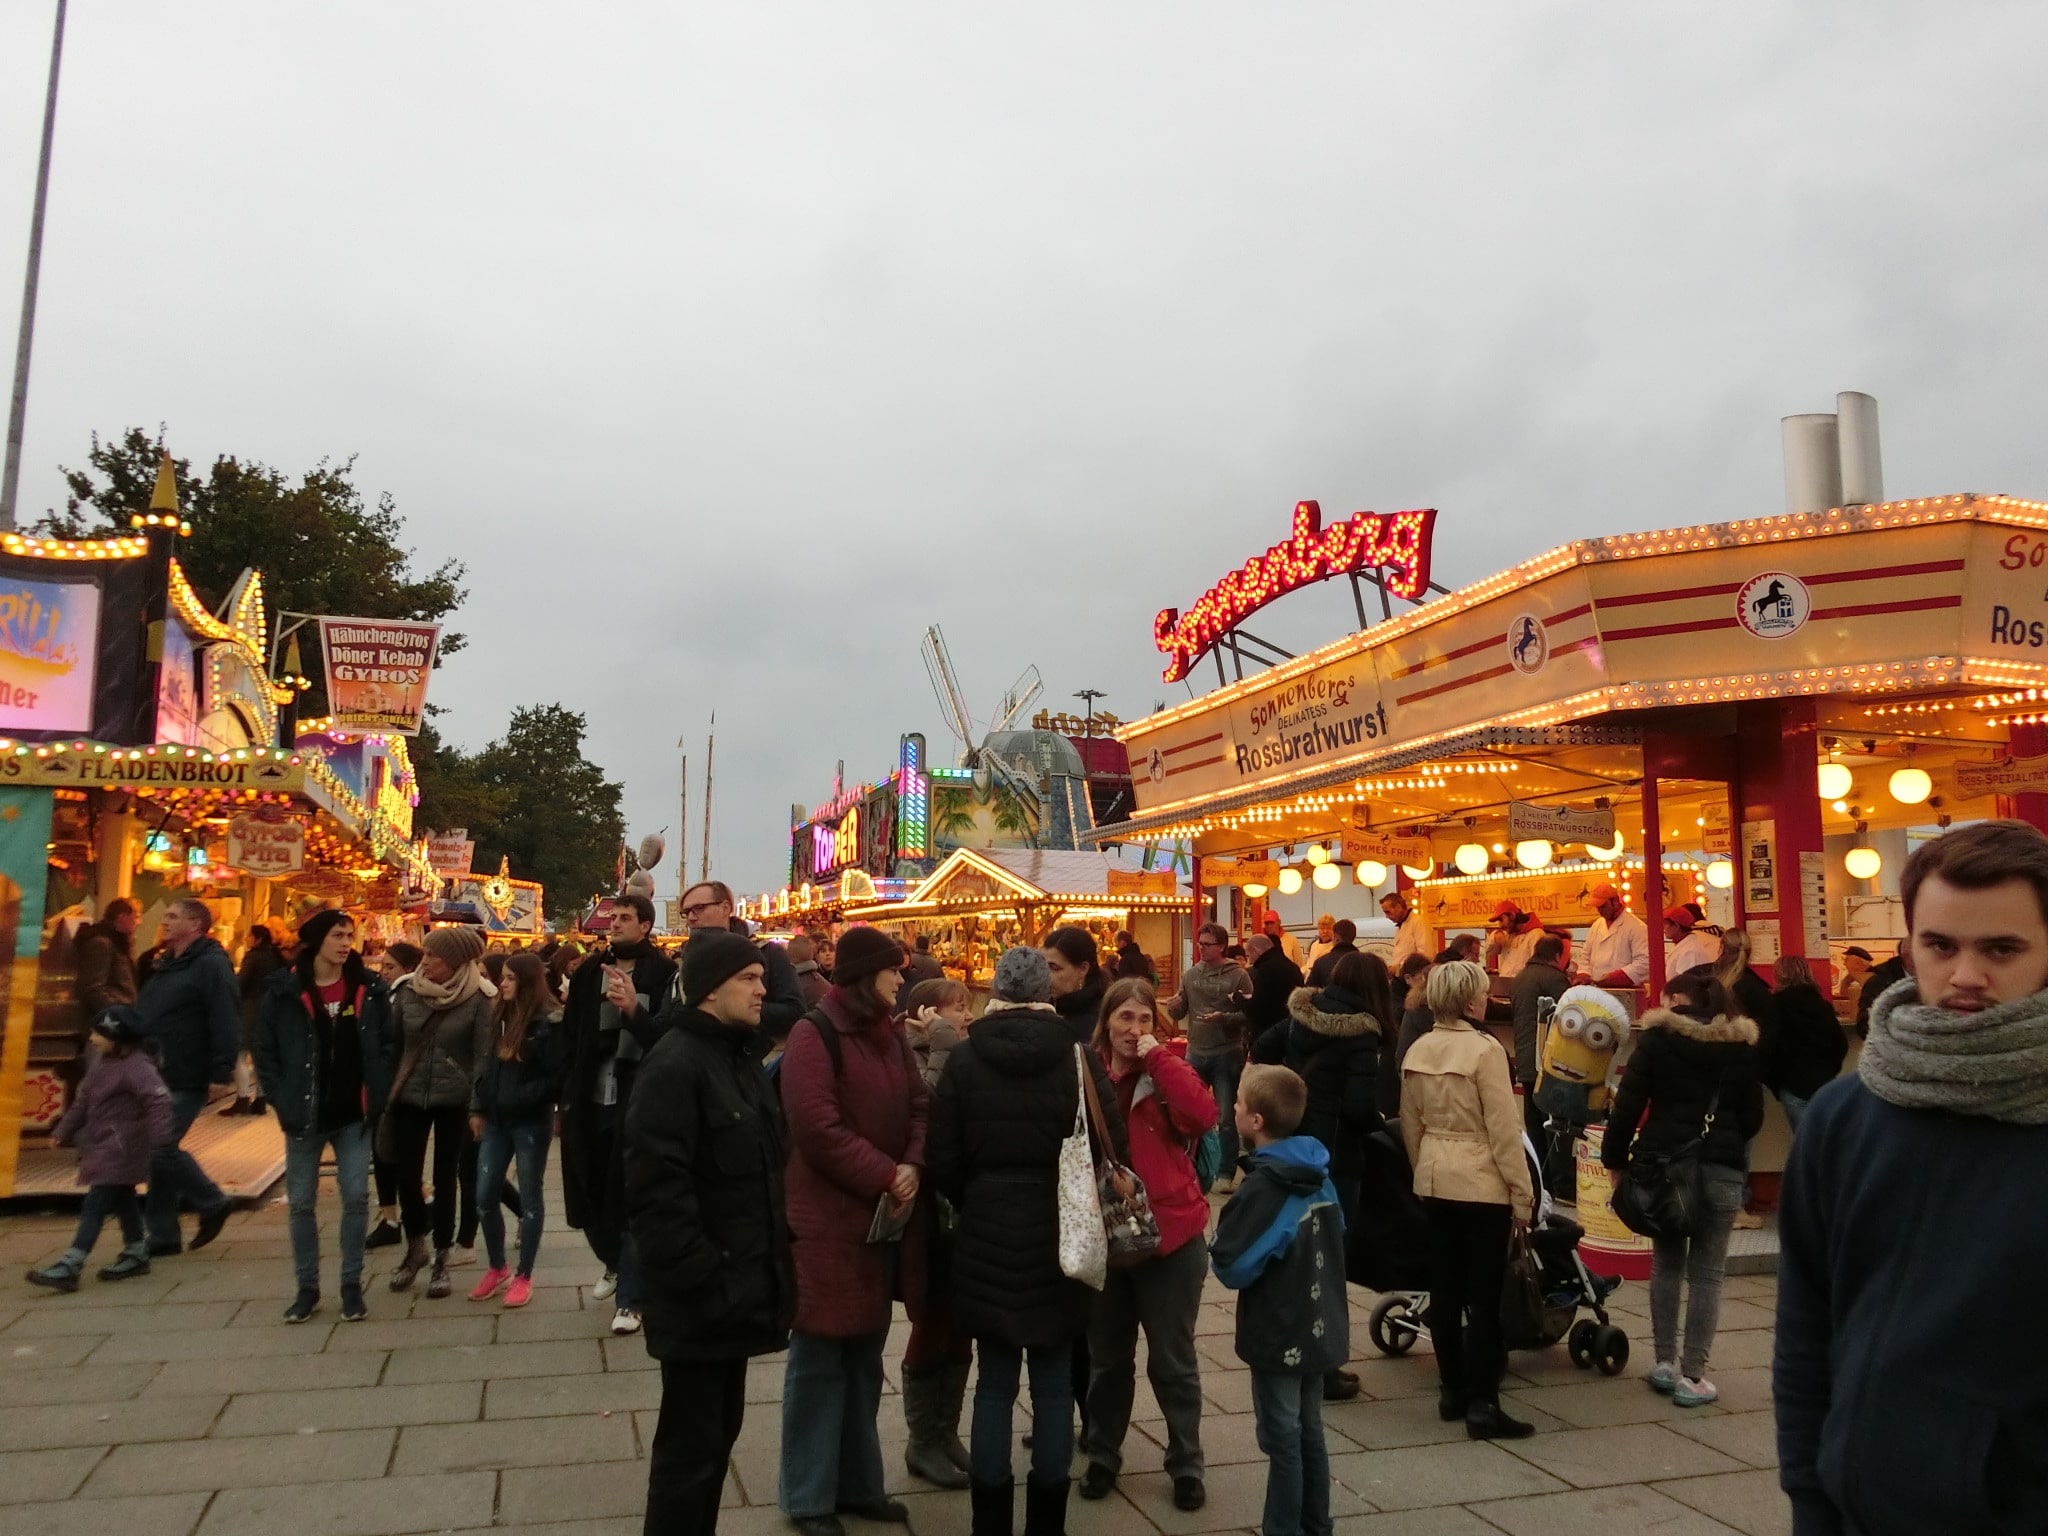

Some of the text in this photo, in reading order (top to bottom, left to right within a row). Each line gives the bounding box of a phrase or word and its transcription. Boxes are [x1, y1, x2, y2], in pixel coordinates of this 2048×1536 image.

[1154, 500, 1435, 683] Sonnenberg
[1991, 605, 2048, 647] Ros
[329, 627, 430, 649] Hähnchengyros
[331, 646, 425, 667] Döner Kebab
[335, 665, 420, 685] GYROS
[340, 713, 414, 725] ORIENT-GRILL
[1278, 703, 1328, 730] DELIKATESS
[1236, 700, 1388, 776] Rossbratwurst
[79, 758, 249, 783] FLADENBROT
[1513, 818, 1611, 835] ROSSBRATWÜRSTCHEN
[813, 806, 858, 874] TOPPER
[1347, 841, 1425, 859] POMMES FRITES
[1461, 893, 1561, 915] ROSSBTWURST
